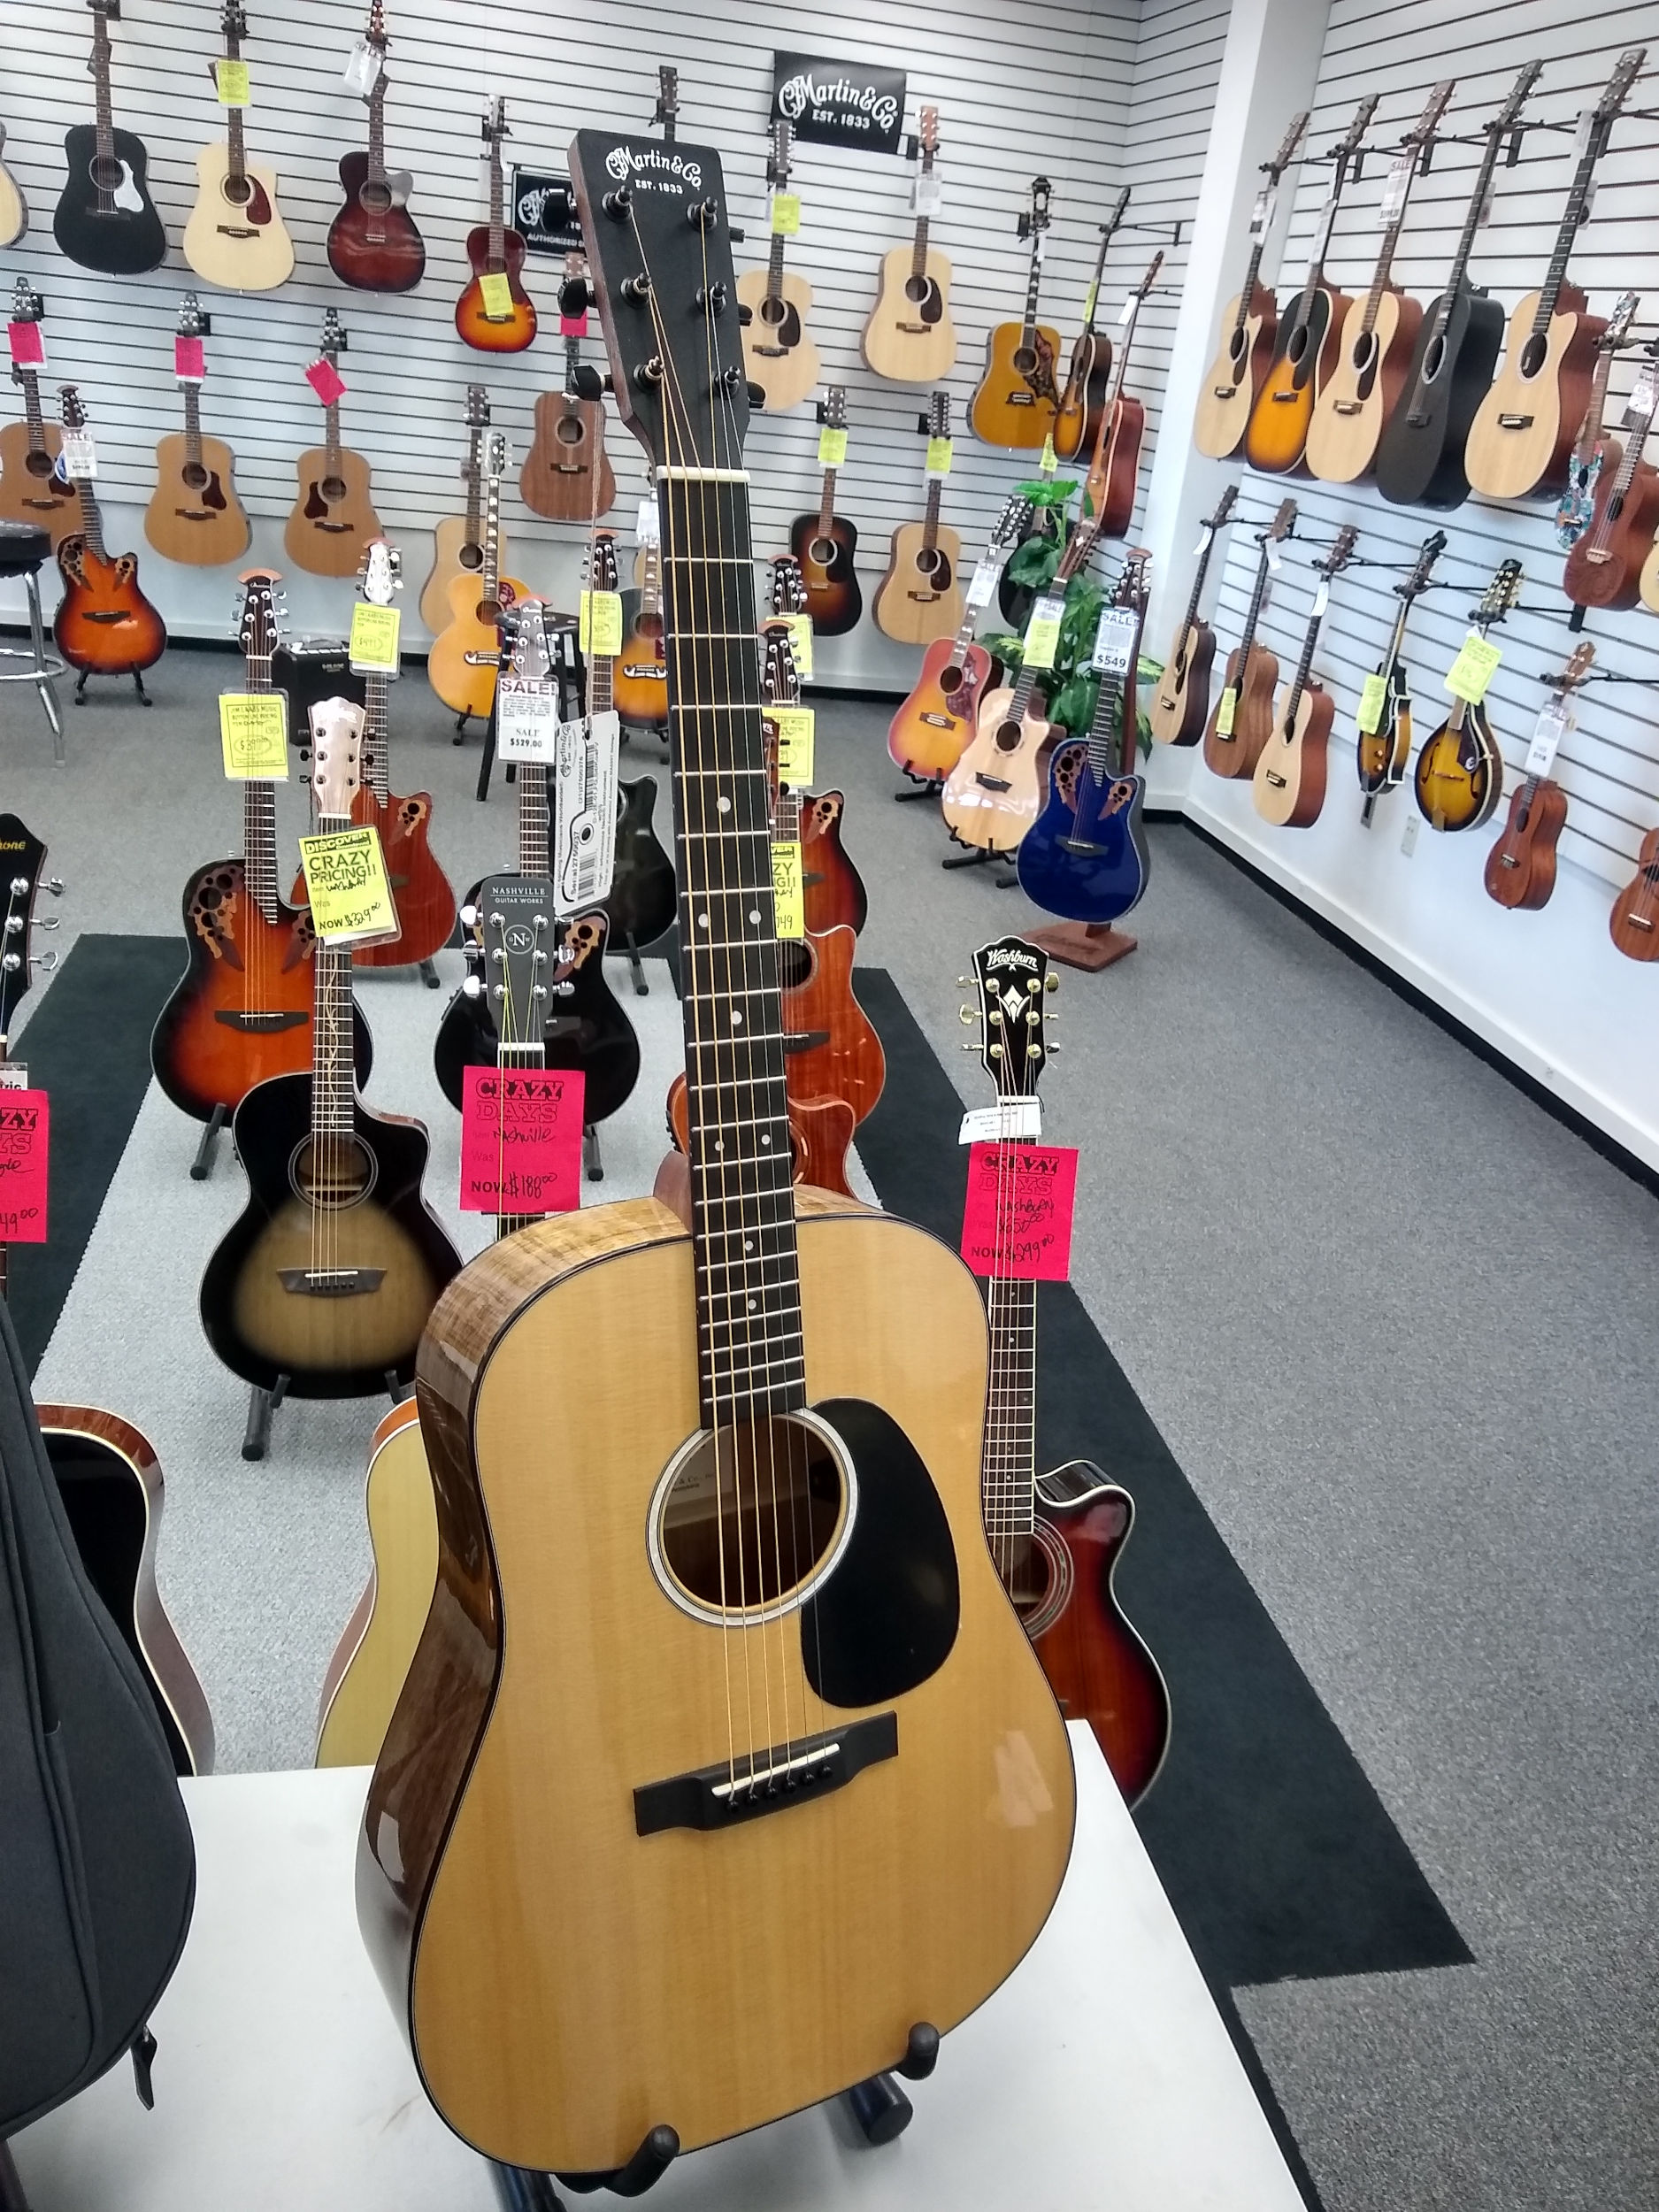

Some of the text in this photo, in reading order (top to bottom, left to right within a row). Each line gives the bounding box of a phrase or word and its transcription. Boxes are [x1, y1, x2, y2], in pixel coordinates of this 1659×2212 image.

[811, 109, 871, 130] EST. 1833
[634, 179, 684, 195] EST. 1833
[1096, 655, 1126, 669] $549
[501, 679, 556, 696] SALE!
[510, 737, 542, 748] $529.00
[305, 833, 368, 855] DISCOVER
[309, 849, 372, 872] CRAZY
[310, 864, 377, 885] PRICING!!
[492, 887, 546, 895] NASHVILLE
[319, 918, 343, 930] NOW
[986, 949, 1038, 969] Washburn
[476, 1077, 565, 1102] CRAZY
[476, 1101, 558, 1124] DAYS
[980, 1151, 1060, 1176] CRAZY
[471, 1181, 504, 1194] NOW
[979, 1172, 1053, 1196] DAYS
